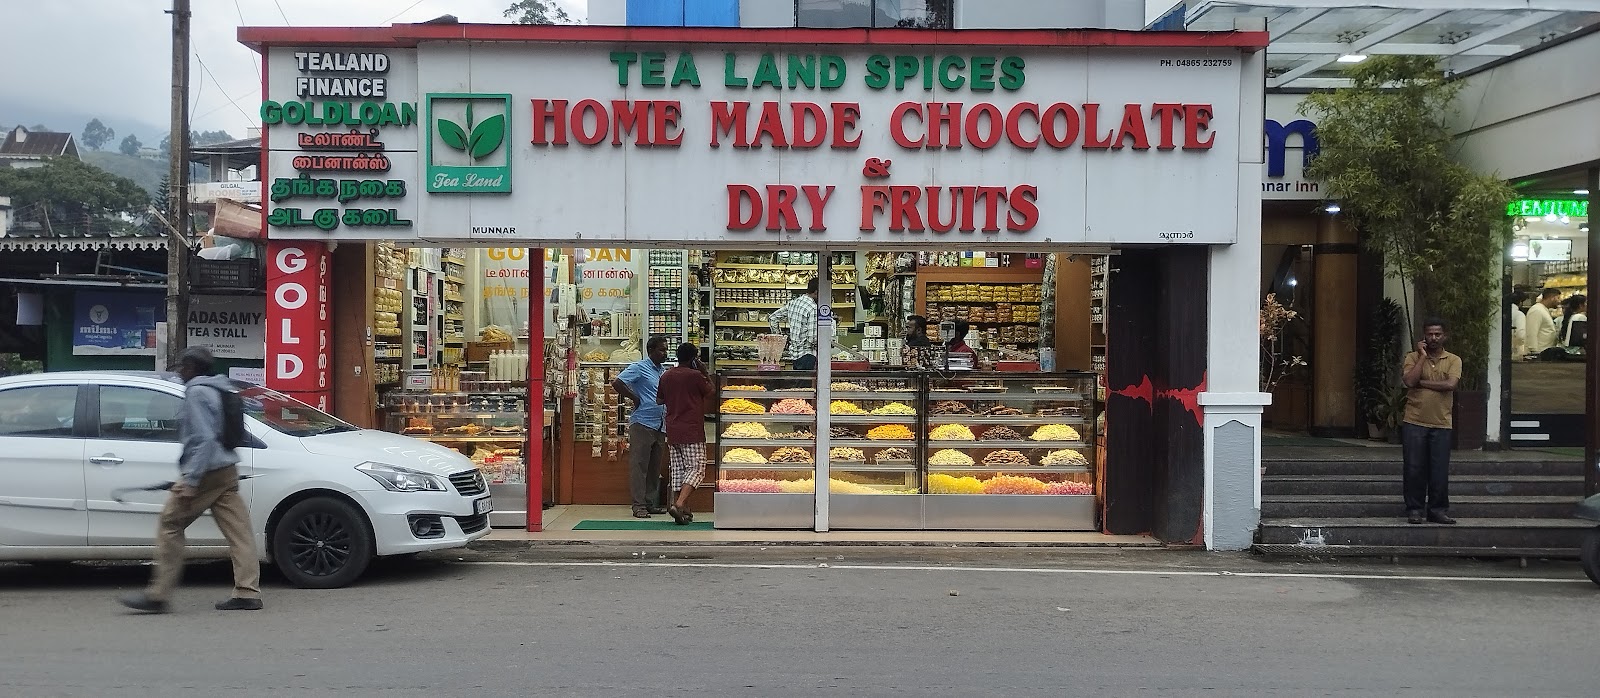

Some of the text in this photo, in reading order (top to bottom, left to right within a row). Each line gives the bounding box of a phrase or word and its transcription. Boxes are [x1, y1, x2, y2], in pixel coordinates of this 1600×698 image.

[295, 52, 389, 73] TEALAND
[610, 52, 1026, 91] TEA LAND SPICES
[1160, 59, 1233, 67] PH. 04865 232759
[297, 77, 386, 98] FINANCE
[260, 100, 418, 126] GOLDLOAN
[530, 98, 1216, 151] HOME MADE CHOCOLATE
[298, 128, 384, 149] டீலாண்ட்
[292, 152, 391, 172] பைனான்ஸ்
[862, 157, 891, 178] &
[271, 173, 407, 205] தங்க நகை
[432, 173, 504, 188] Tea Land
[726, 184, 1040, 232] DRY FRUITS
[267, 207, 414, 231] அடகு கடை
[472, 226, 516, 234] MUNNAR
[187, 310, 262, 325] ADASAMY
[274, 247, 308, 380] GOLD
[187, 327, 248, 339] TEA STALL
